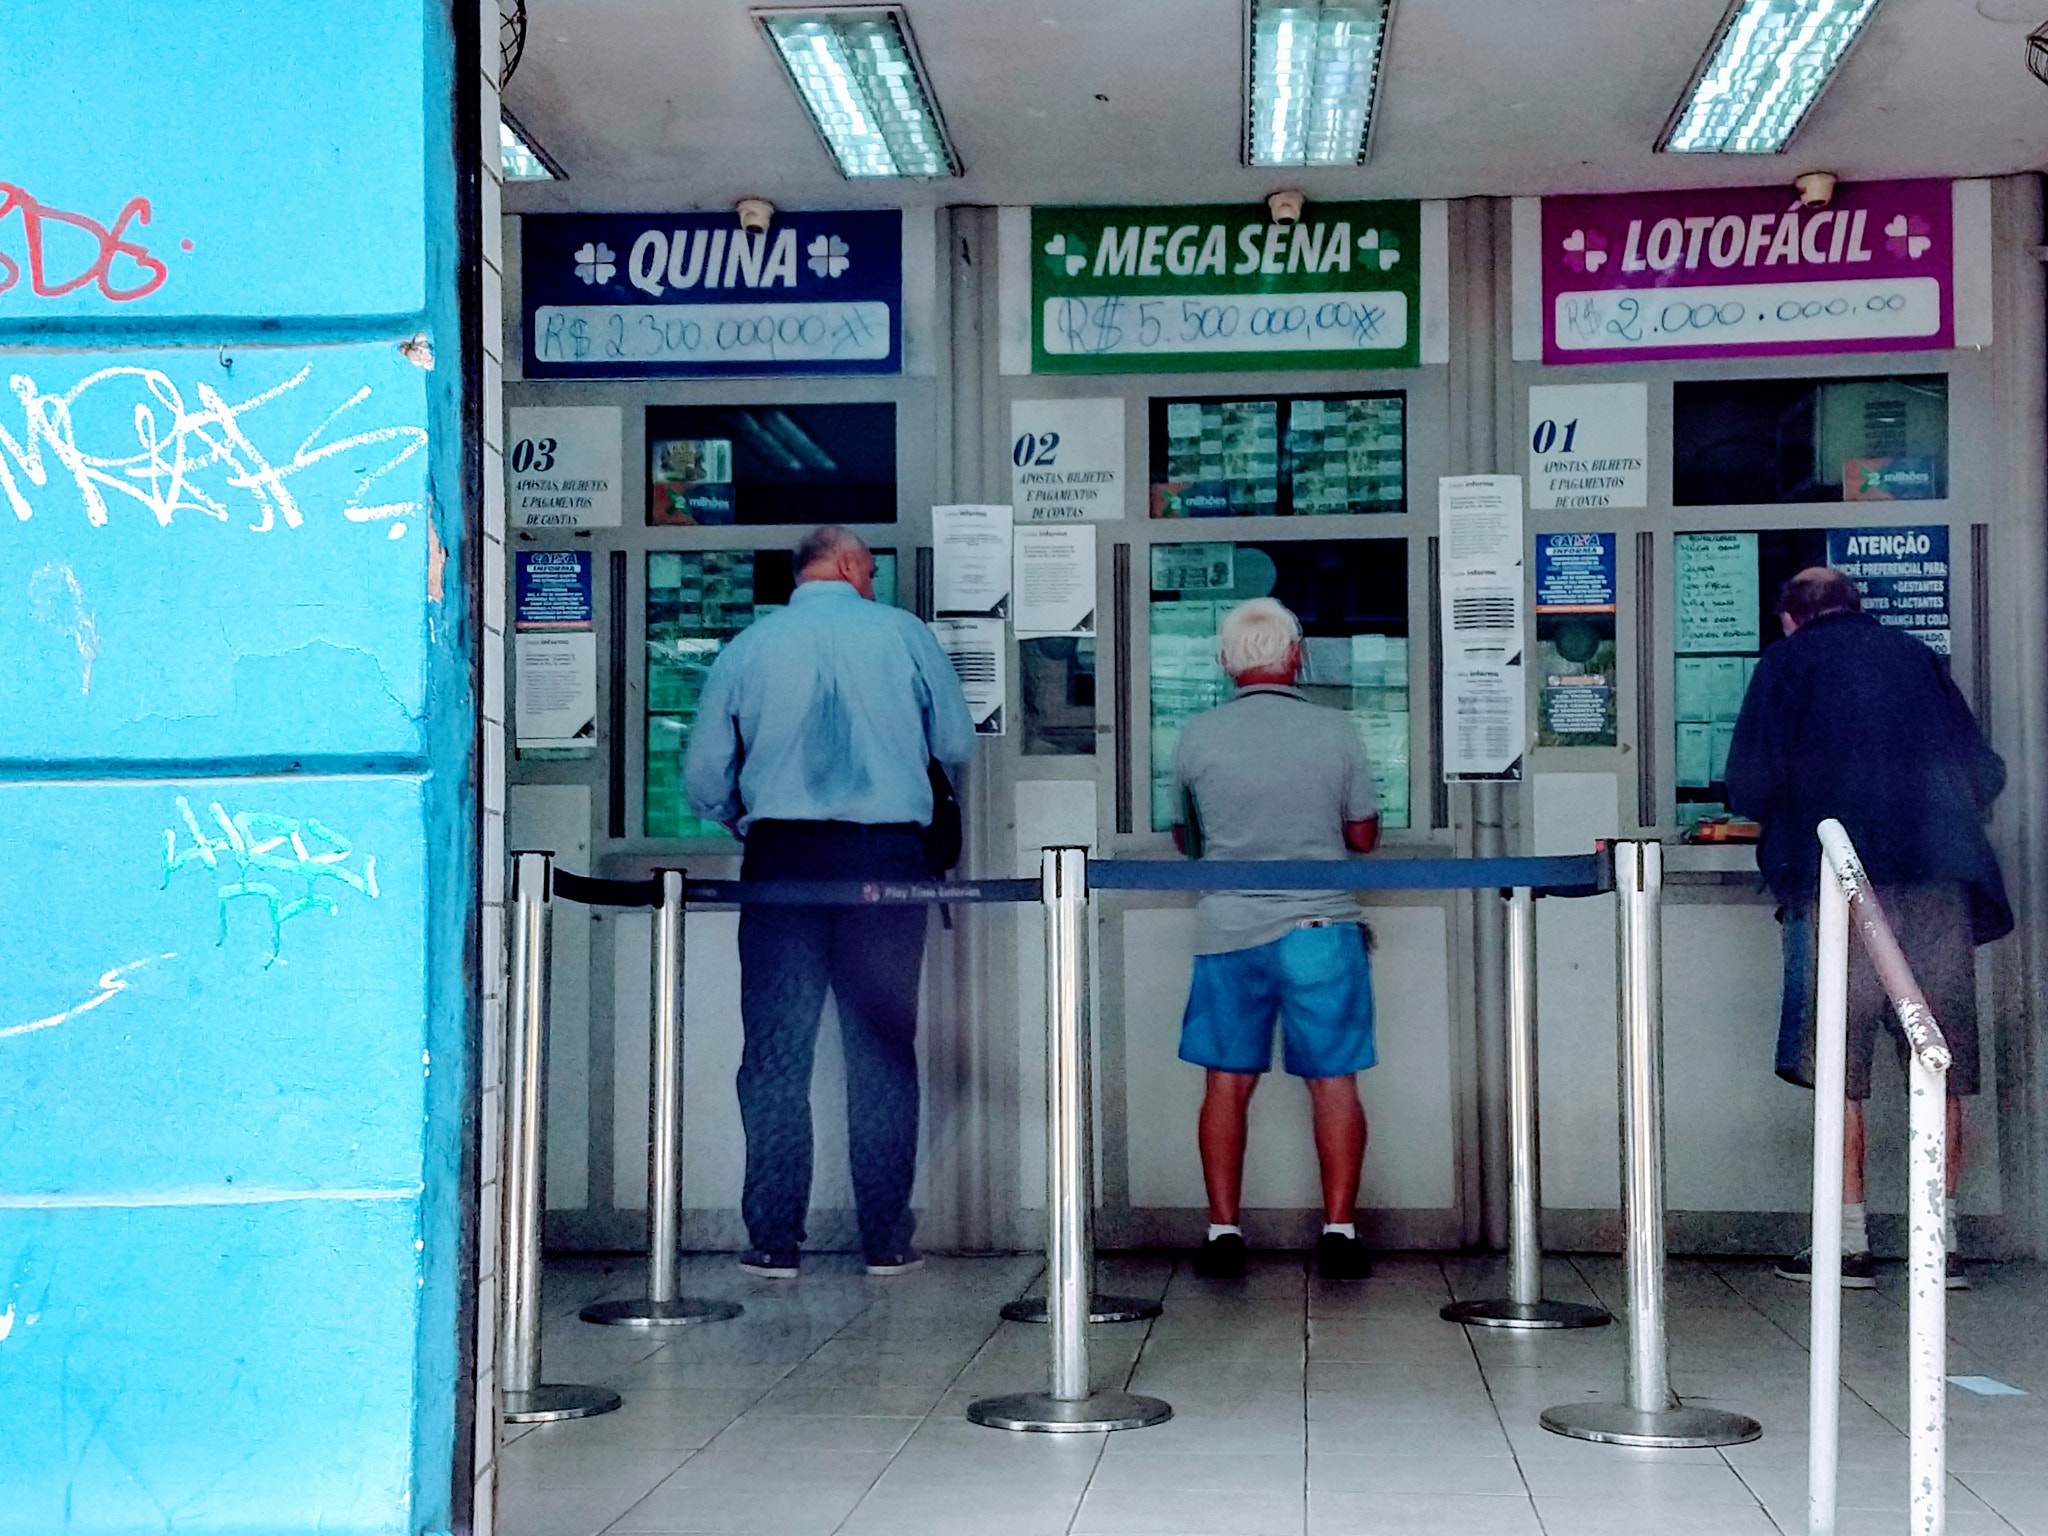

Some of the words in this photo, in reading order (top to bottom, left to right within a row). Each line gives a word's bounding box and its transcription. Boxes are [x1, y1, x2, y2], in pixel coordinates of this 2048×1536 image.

[1621, 200, 1872, 272] LOTOFÁCIL
[1093, 224, 1227, 277] MEGA
[1233, 221, 1352, 274] SENA
[628, 228, 798, 297] QUINA
[1532, 417, 1578, 454] 01
[512, 437, 558, 473] 03
[1013, 432, 1061, 467] 02
[1591, 457, 1642, 472] BILHETES
[1549, 479, 1558, 491] E
[1558, 476, 1626, 490] PAGAMENTOS
[1035, 488, 1099, 502] PAGAMENTOS
[1555, 497, 1570, 508] DE
[1571, 495, 1610, 507] CONTAS
[1032, 507, 1045, 519] DE
[1047, 506, 1085, 519] CONTAS
[1550, 534, 1601, 547] CAIXA
[1847, 531, 1931, 559] ATENÇÃO
[531, 552, 578, 564] CAIXA
[1552, 547, 1598, 555] INFORMA
[1862, 562, 1923, 576] PREFERENCIAL
[1898, 580, 1945, 593] GESTANTES
[1898, 596, 1945, 608] LACTANTES
[1880, 614, 1914, 628] CRIANÇA
[1915, 614, 1926, 625] DE
[1927, 613, 1949, 626] COLO
